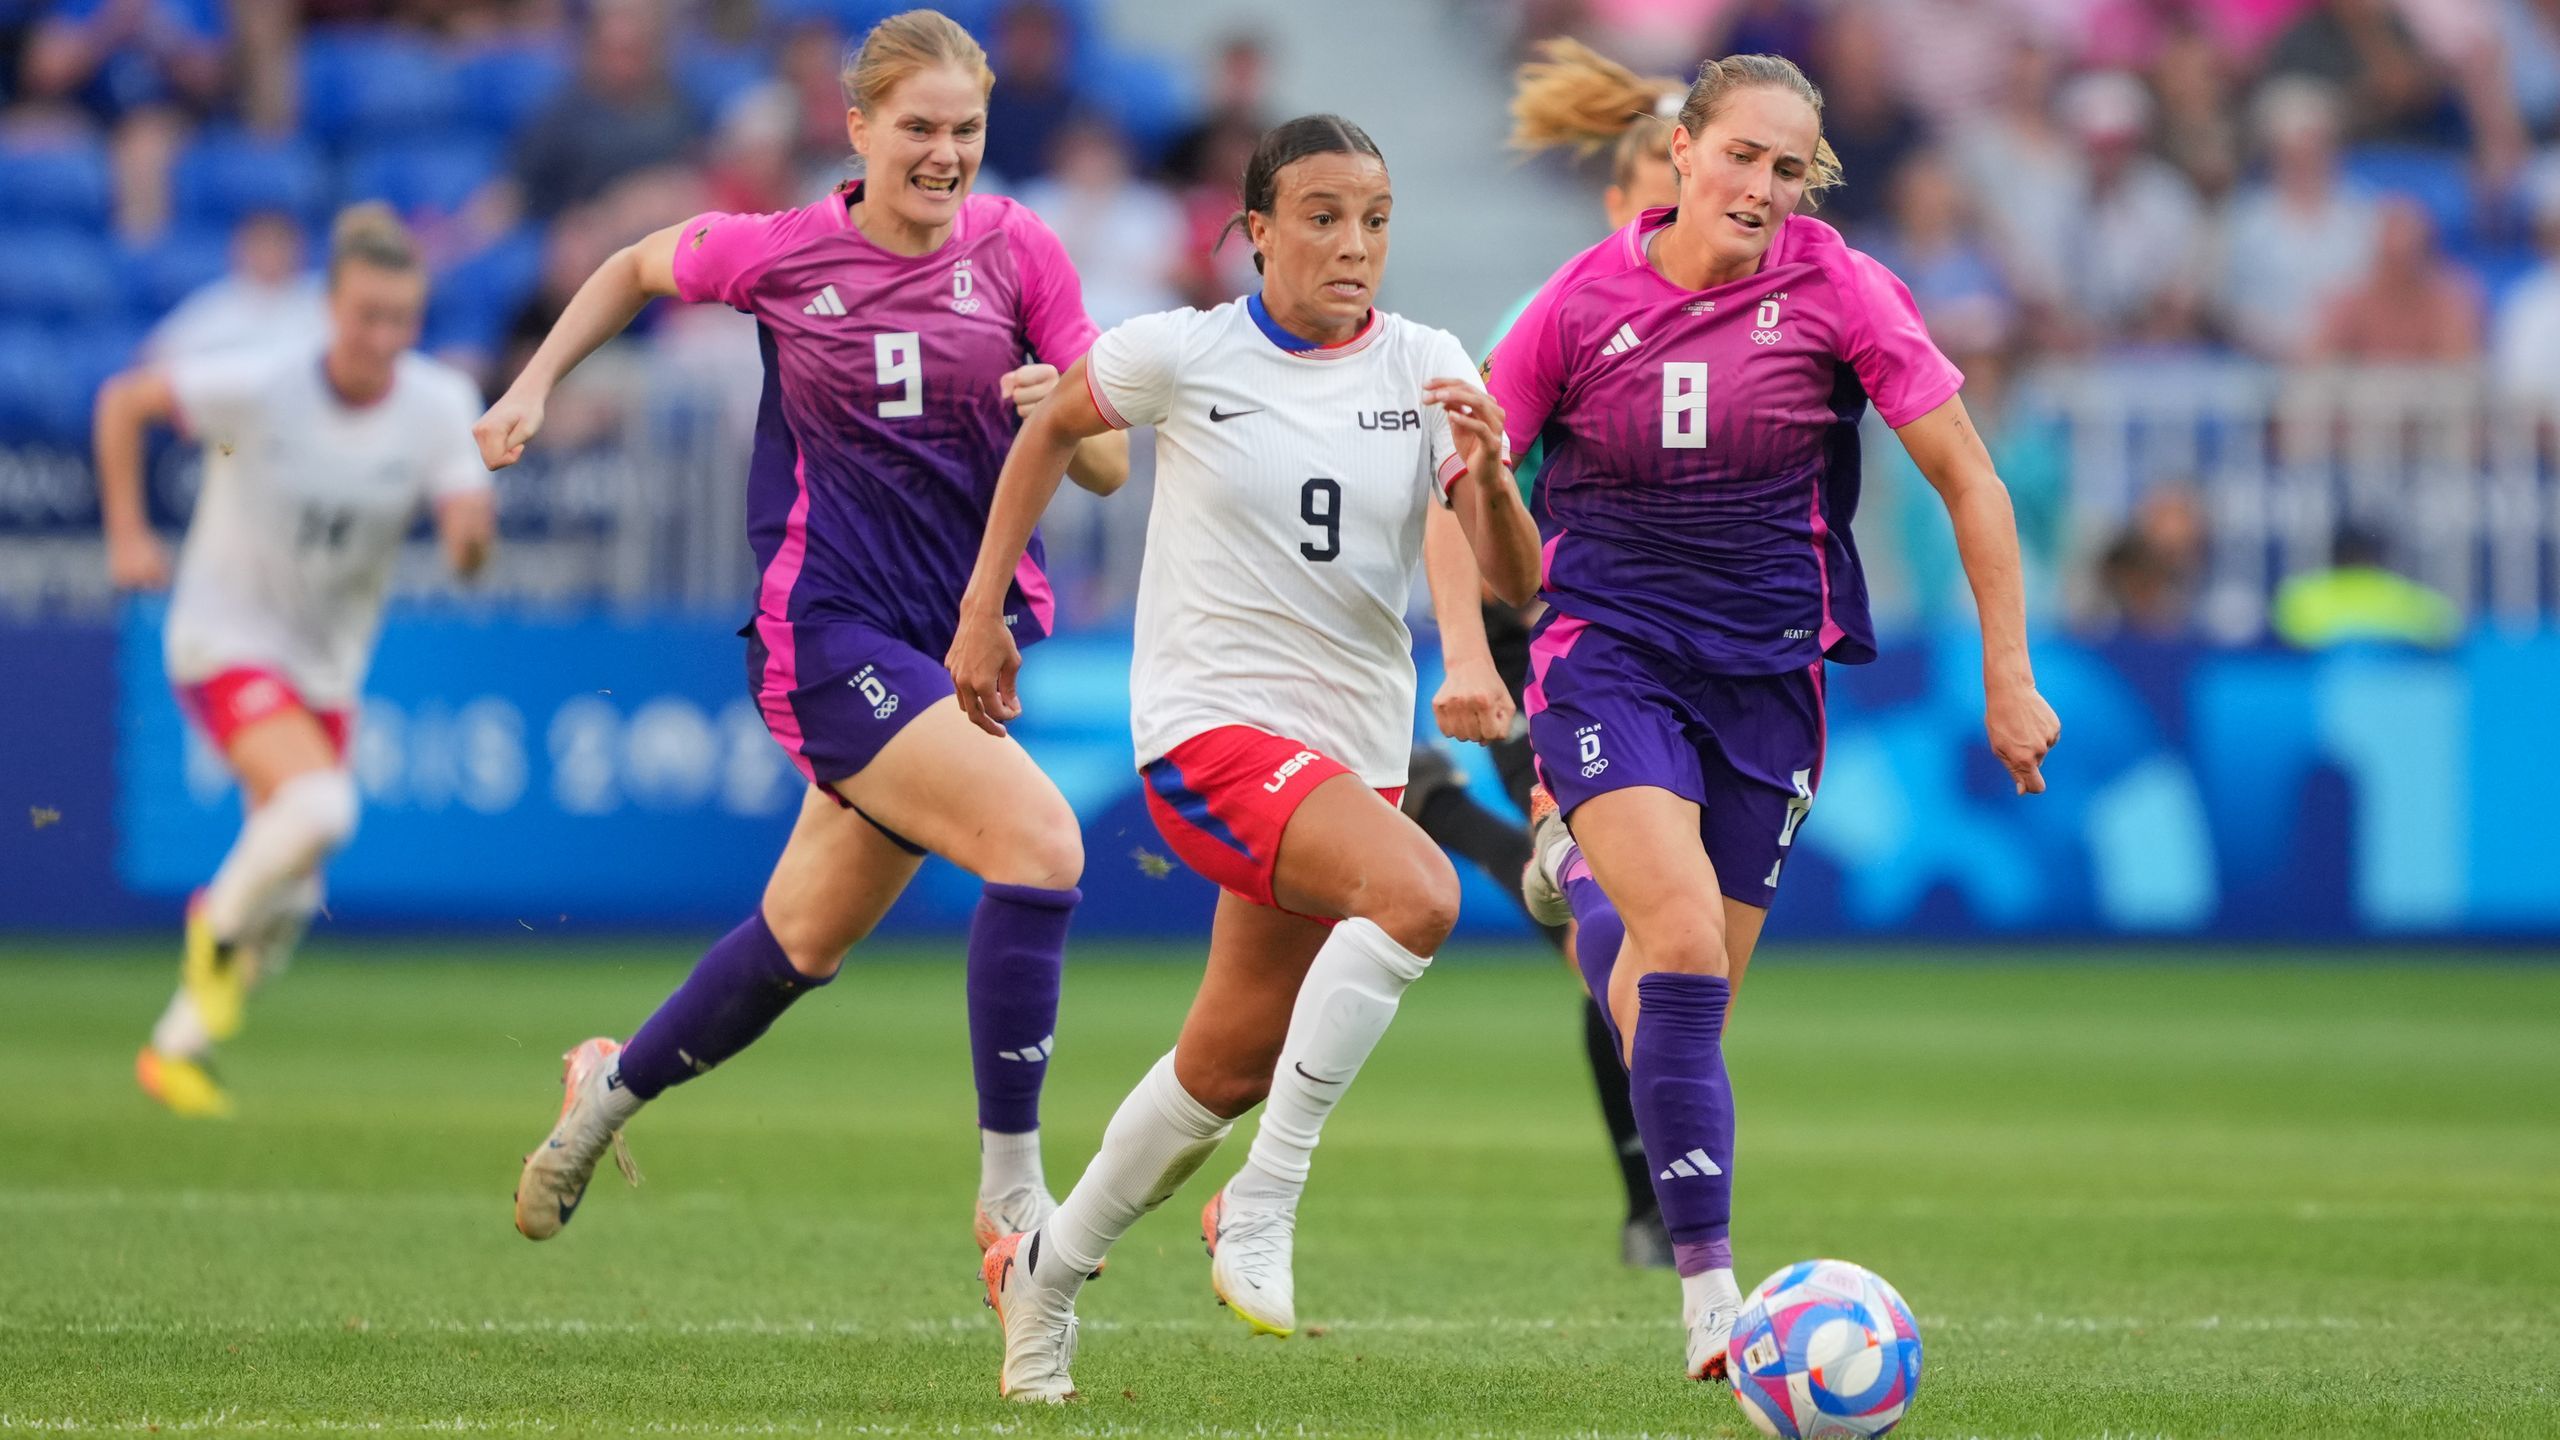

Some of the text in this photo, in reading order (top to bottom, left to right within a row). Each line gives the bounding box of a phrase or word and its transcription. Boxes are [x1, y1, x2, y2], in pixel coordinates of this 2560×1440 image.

[953, 270, 972, 299] D
[1757, 300, 1780, 328] D
[874, 332, 923, 418] 9
[1357, 408, 1421, 431] USA
[1662, 362, 1708, 449] 8
[1300, 478, 1341, 562] 9
[847, 664, 874, 688] TEAM
[860, 676, 886, 707] D
[1575, 722, 1602, 738] TEAM
[1580, 733, 1601, 763] D
[1263, 750, 1321, 794] USA
